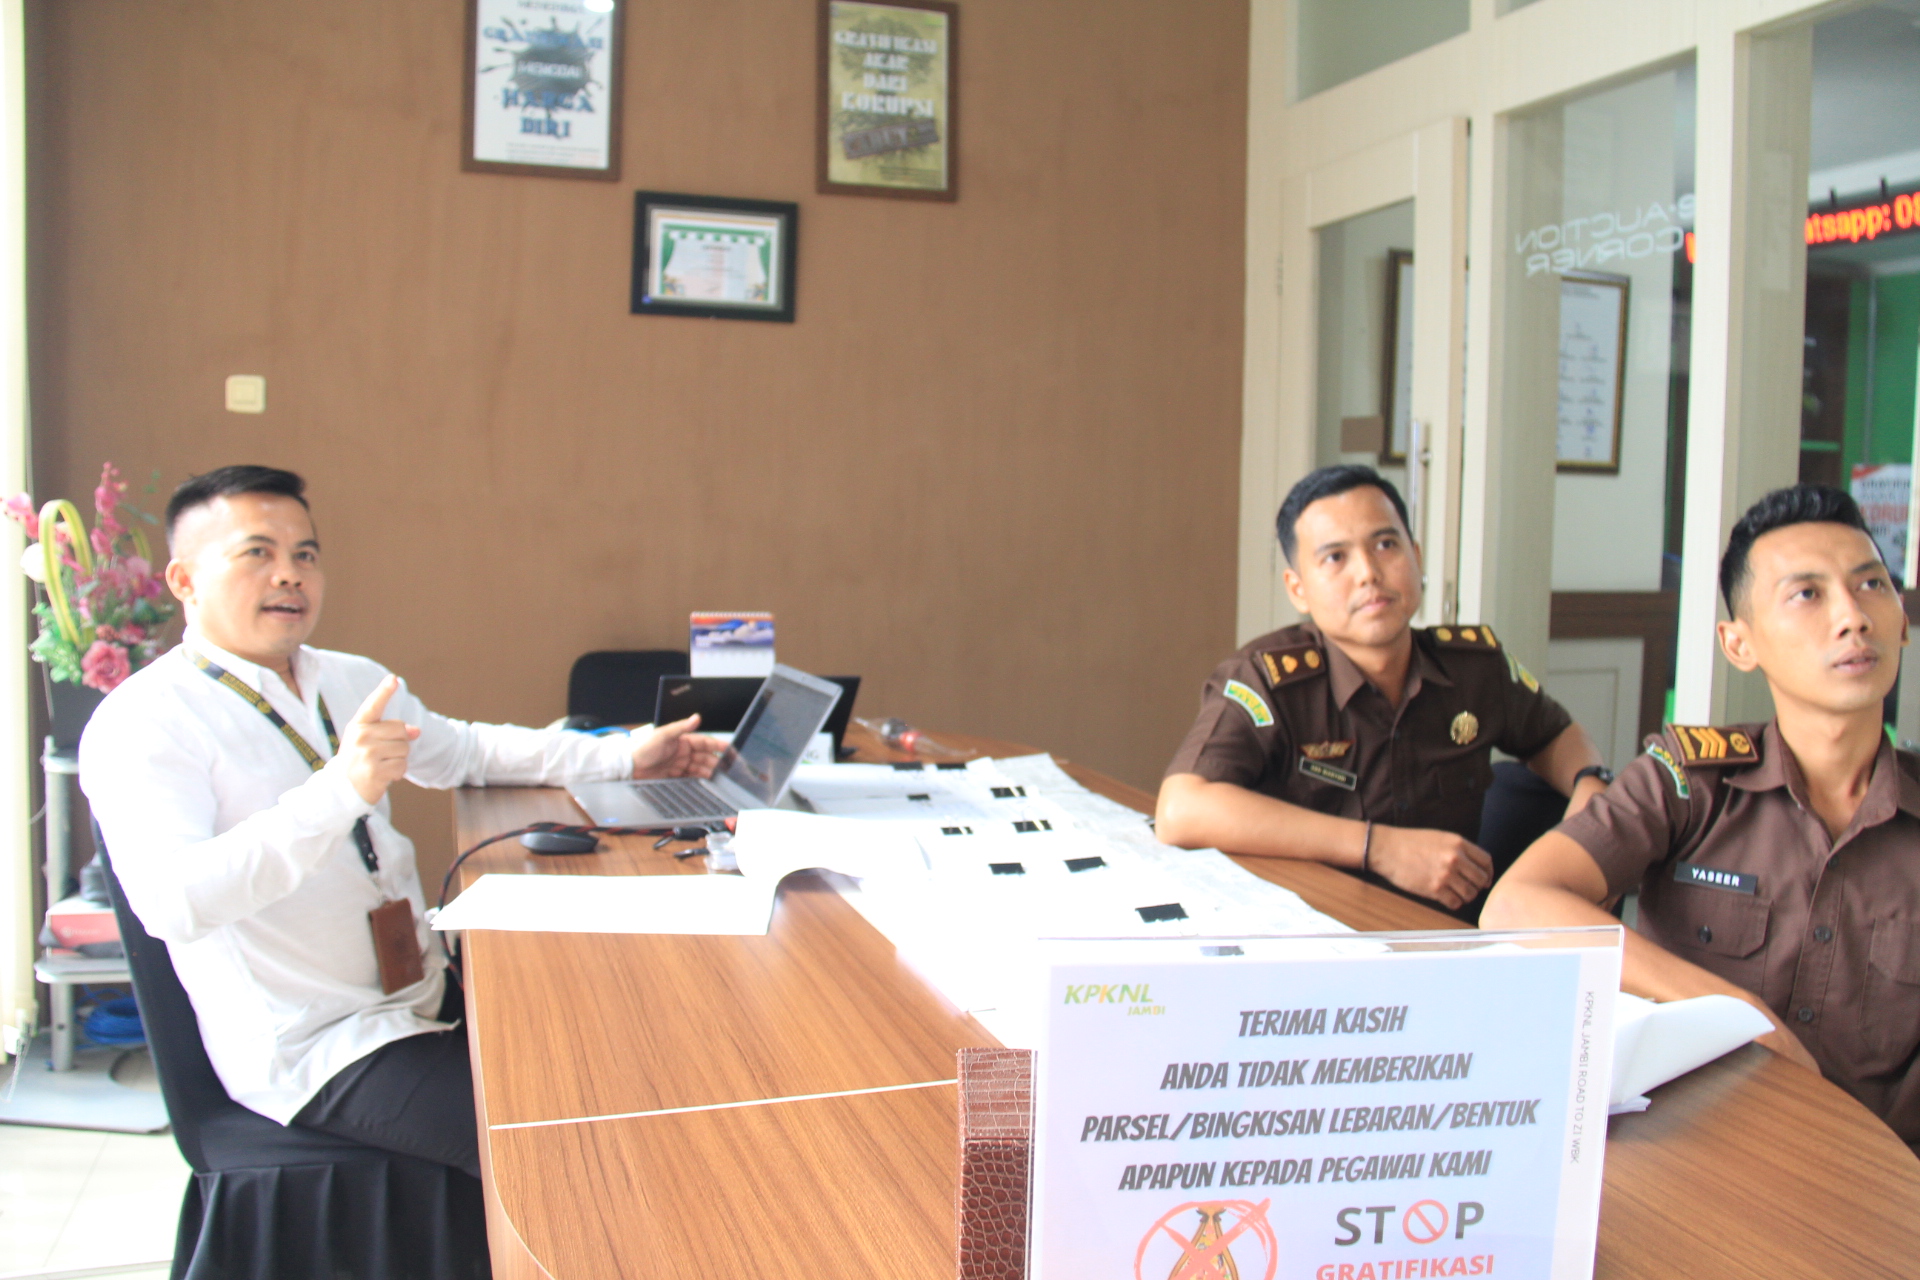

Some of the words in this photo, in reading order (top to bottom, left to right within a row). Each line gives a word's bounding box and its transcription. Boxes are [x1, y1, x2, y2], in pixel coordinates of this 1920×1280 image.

[1063, 983, 1154, 1004] KPKNL
[1581, 990, 1595, 1029] KPKNL
[1238, 1008, 1328, 1037] TERIMA
[1332, 1005, 1409, 1034] KASIH
[1578, 1032, 1591, 1067] JAMBI
[1159, 1062, 1230, 1090] ANDA
[1237, 1058, 1311, 1088] TIDAK
[1310, 1052, 1474, 1085] MEMBERIKAN
[1575, 1070, 1588, 1104] ROAD
[1080, 1108, 1326, 1142] PARSEL/BINGKISAN
[1328, 1098, 1541, 1134] LEBARAN/BENTUK
[1574, 1106, 1585, 1122] TO
[1570, 1138, 1582, 1164] WBK
[1118, 1161, 1217, 1191] APAPUN
[1219, 1157, 1313, 1188] KEPADA
[1317, 1153, 1426, 1183] PEGAWAI
[1428, 1149, 1493, 1178] KAMI
[1315, 1254, 1495, 1280] GRATIFIKASI
